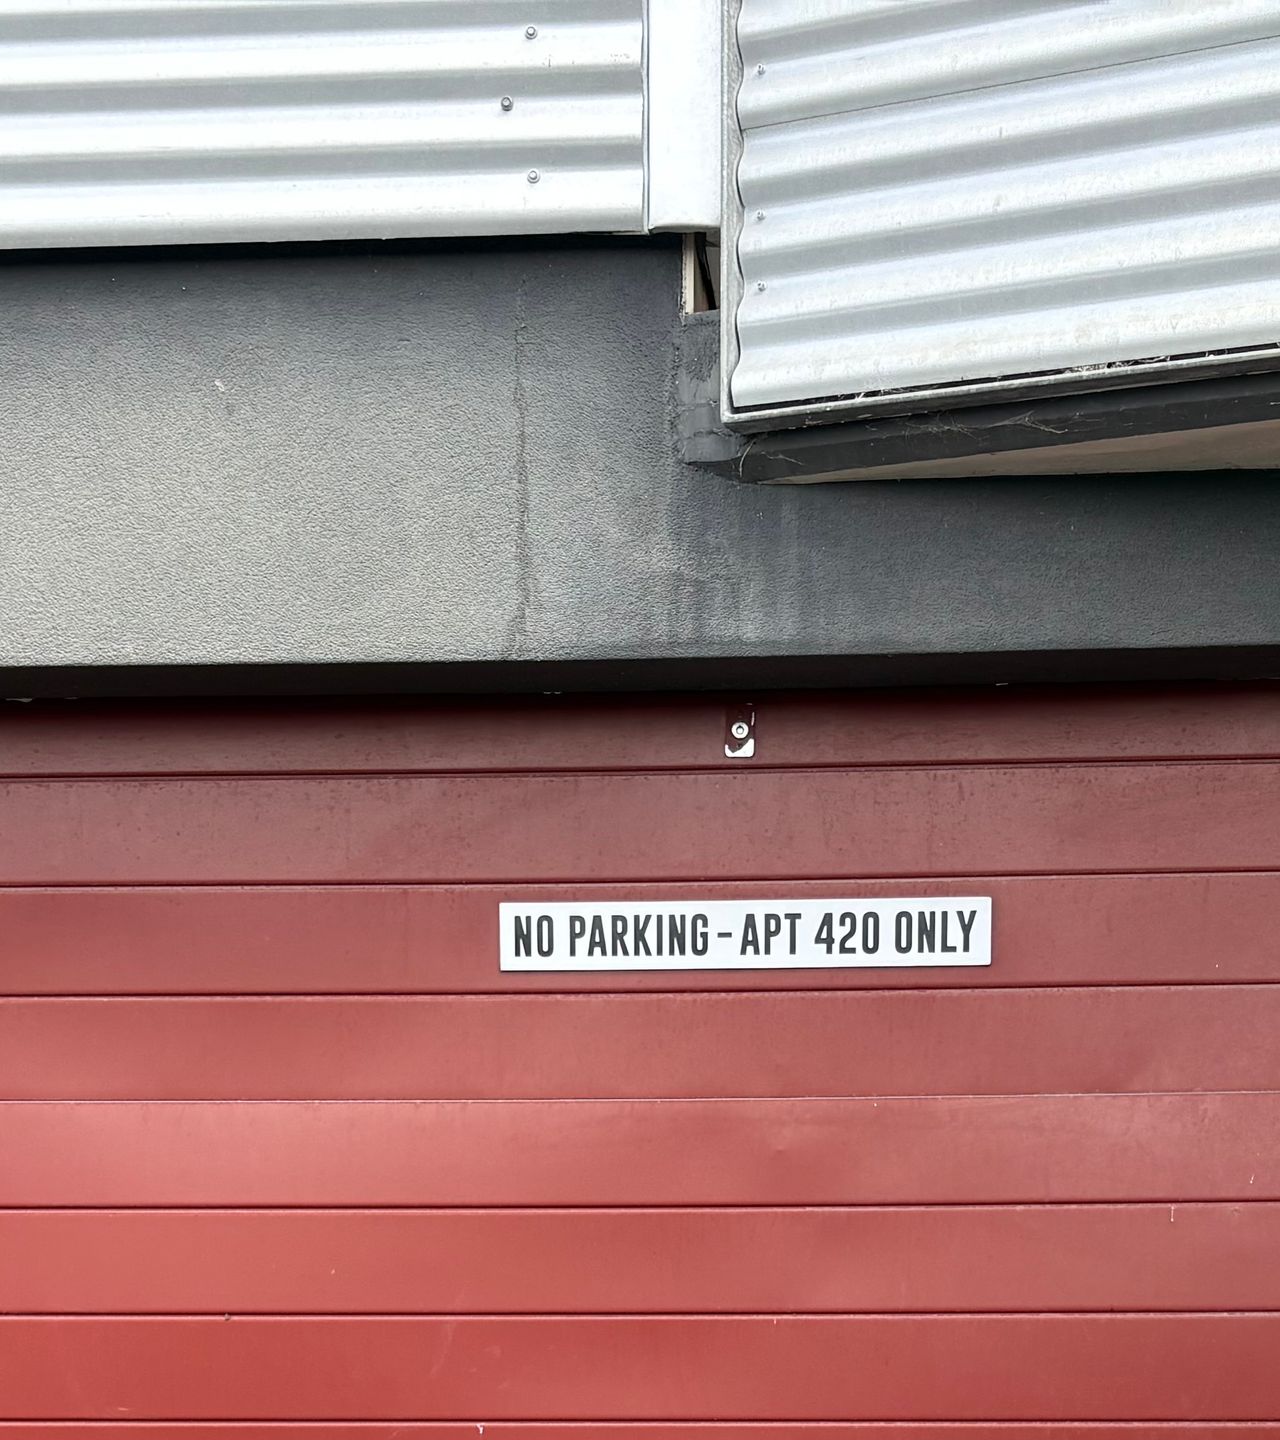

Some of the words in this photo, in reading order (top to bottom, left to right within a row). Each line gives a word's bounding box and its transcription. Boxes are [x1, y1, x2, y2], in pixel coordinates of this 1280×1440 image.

[515, 915, 553, 957] NO
[815, 912, 879, 954] 420
[895, 910, 977, 953] ONLY
